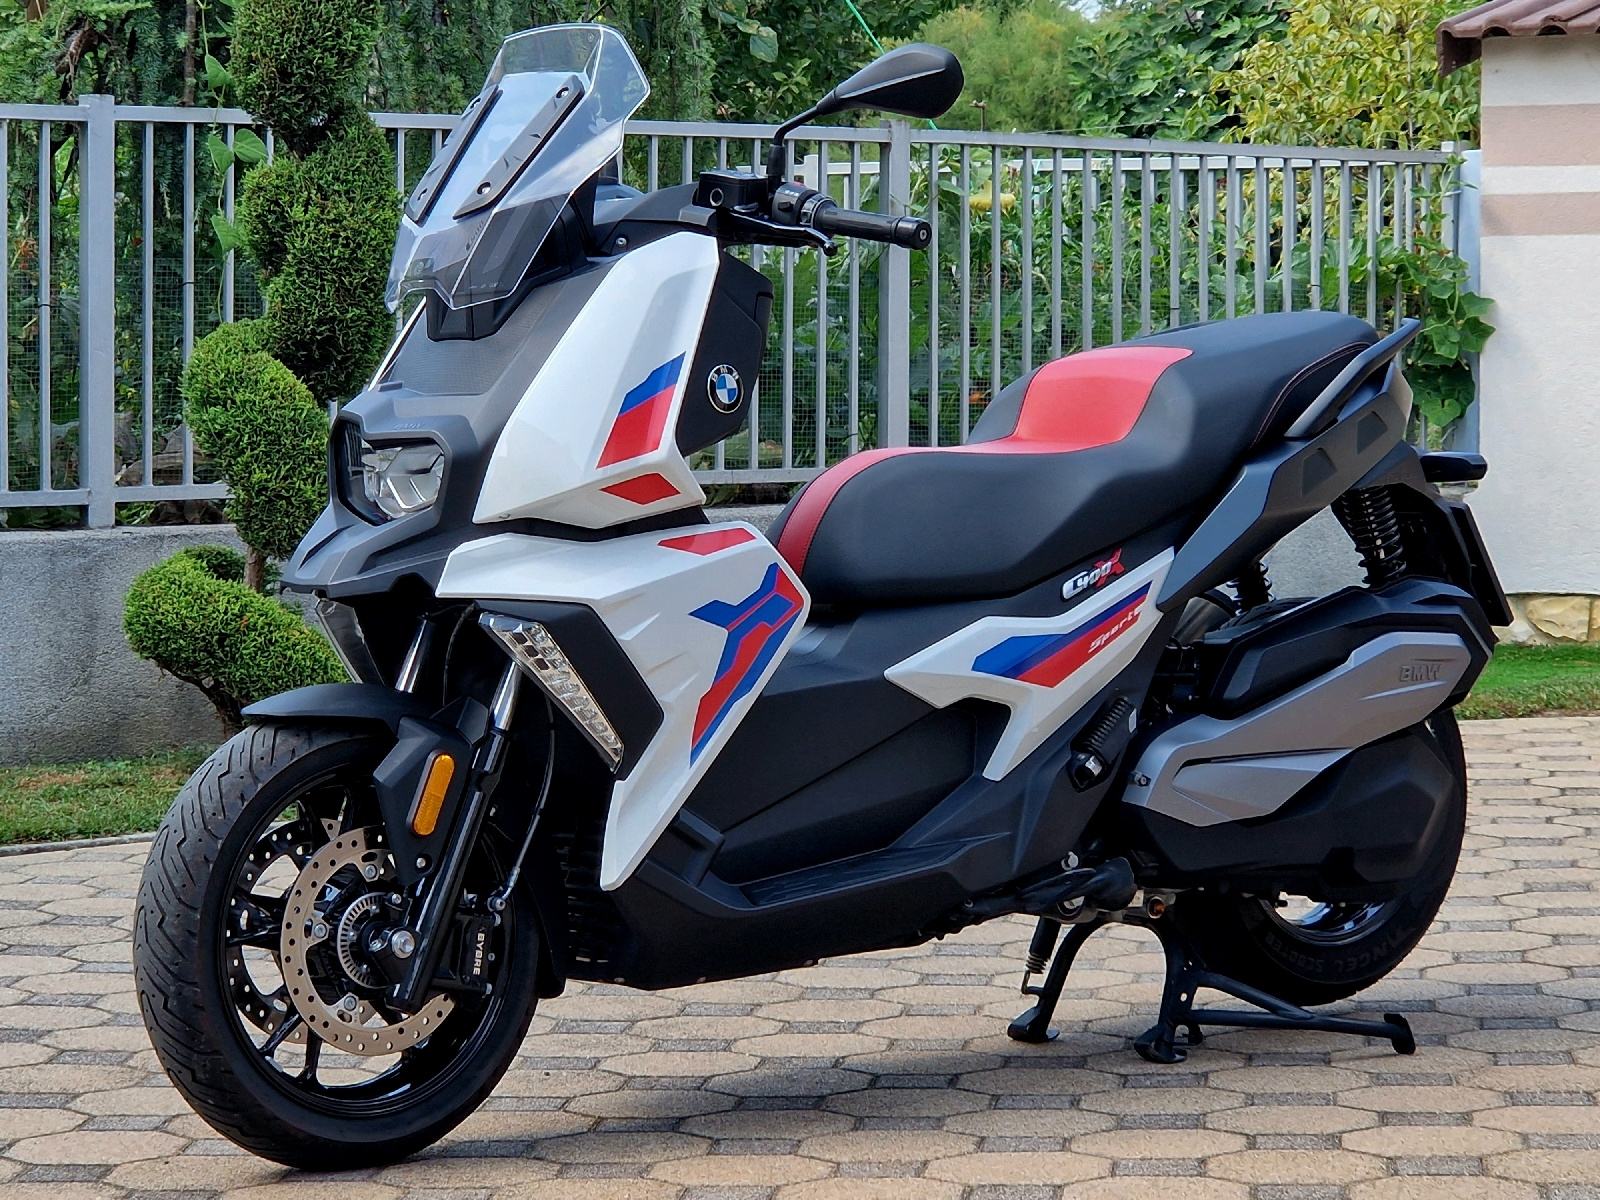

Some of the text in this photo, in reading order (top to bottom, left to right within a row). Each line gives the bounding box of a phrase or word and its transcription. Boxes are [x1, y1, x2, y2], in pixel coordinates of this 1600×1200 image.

[711, 366, 740, 382] BMW
[1400, 664, 1441, 682] BMW
[472, 932, 486, 976] BYBRE
